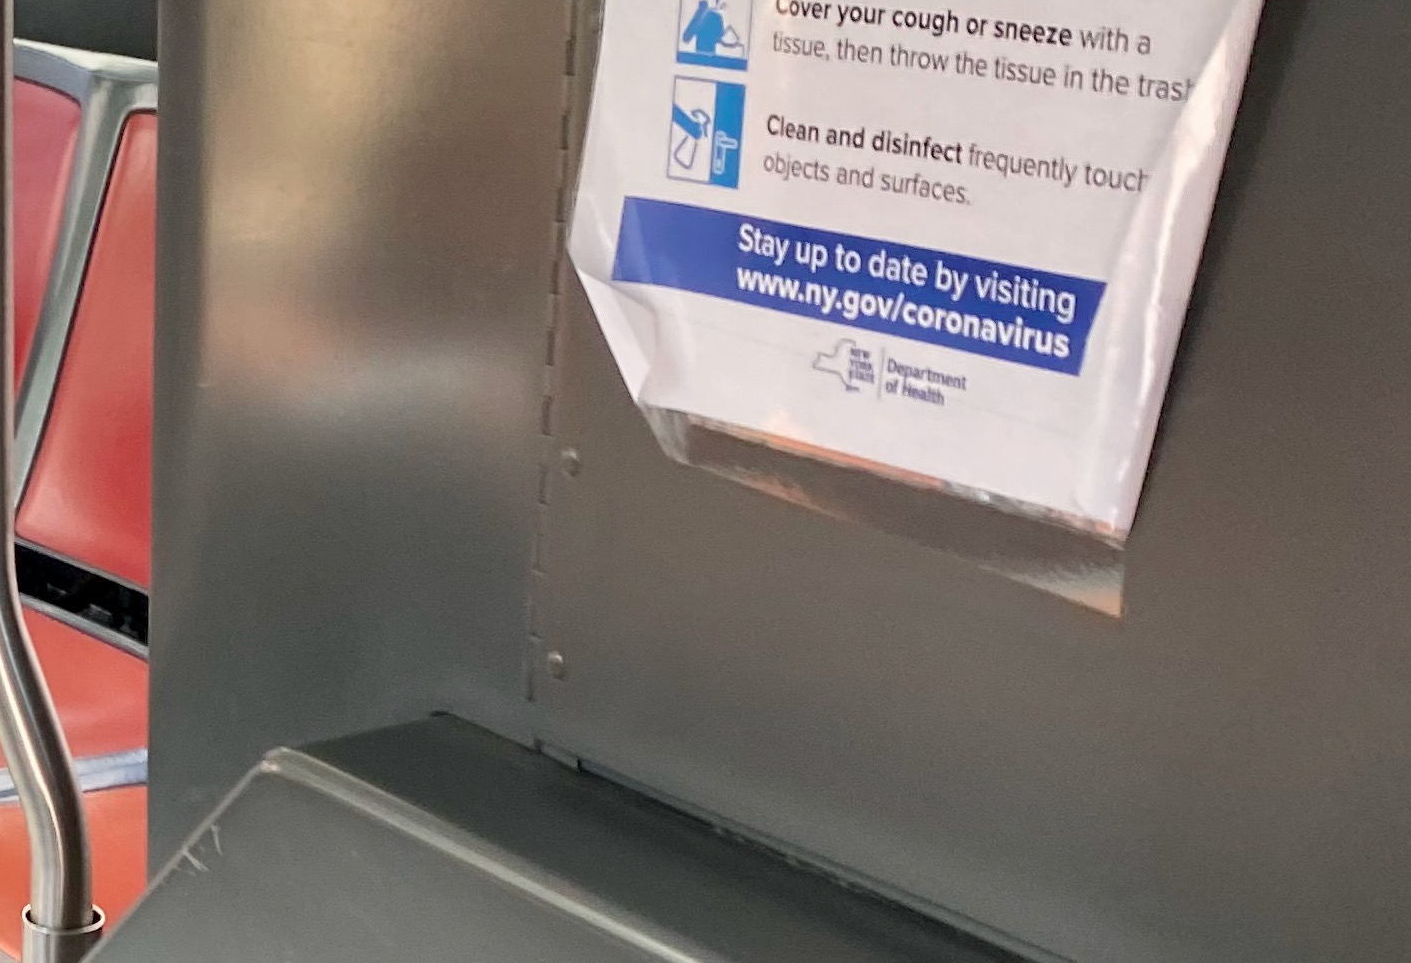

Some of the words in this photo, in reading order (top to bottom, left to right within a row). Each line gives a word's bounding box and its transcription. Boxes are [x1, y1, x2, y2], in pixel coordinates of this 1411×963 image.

[837, 3, 884, 26] your
[892, 9, 959, 37] cough
[966, 16, 988, 36] or
[993, 19, 1072, 47] sneeze
[1079, 25, 1129, 53] with
[1136, 35, 1151, 55] a
[773, 30, 830, 61] tissue,
[837, 37, 882, 65] then
[890, 43, 948, 72] throw
[956, 50, 988, 77] the
[994, 56, 1056, 86] tissue
[1063, 64, 1083, 89] in
[1092, 68, 1129, 95] the
[763, 151, 830, 181] objects
[836, 166, 874, 189] and
[880, 173, 971, 205] surfaces.
[767, 114, 819, 142] Clean
[826, 126, 865, 149] and
[872, 129, 962, 164] disinfect
[969, 143, 1078, 188] frequently
[738, 223, 789, 266] Stay
[795, 241, 827, 273] up
[835, 243, 861, 273] to
[868, 249, 928, 286] date
[935, 260, 969, 300] by
[976, 272, 1076, 324] visiting
[736, 267, 1070, 358] www.ny.gov/coronavirus
[885, 380, 898, 393] of
[902, 382, 945, 406] Health
[887, 357, 967, 391] Department
